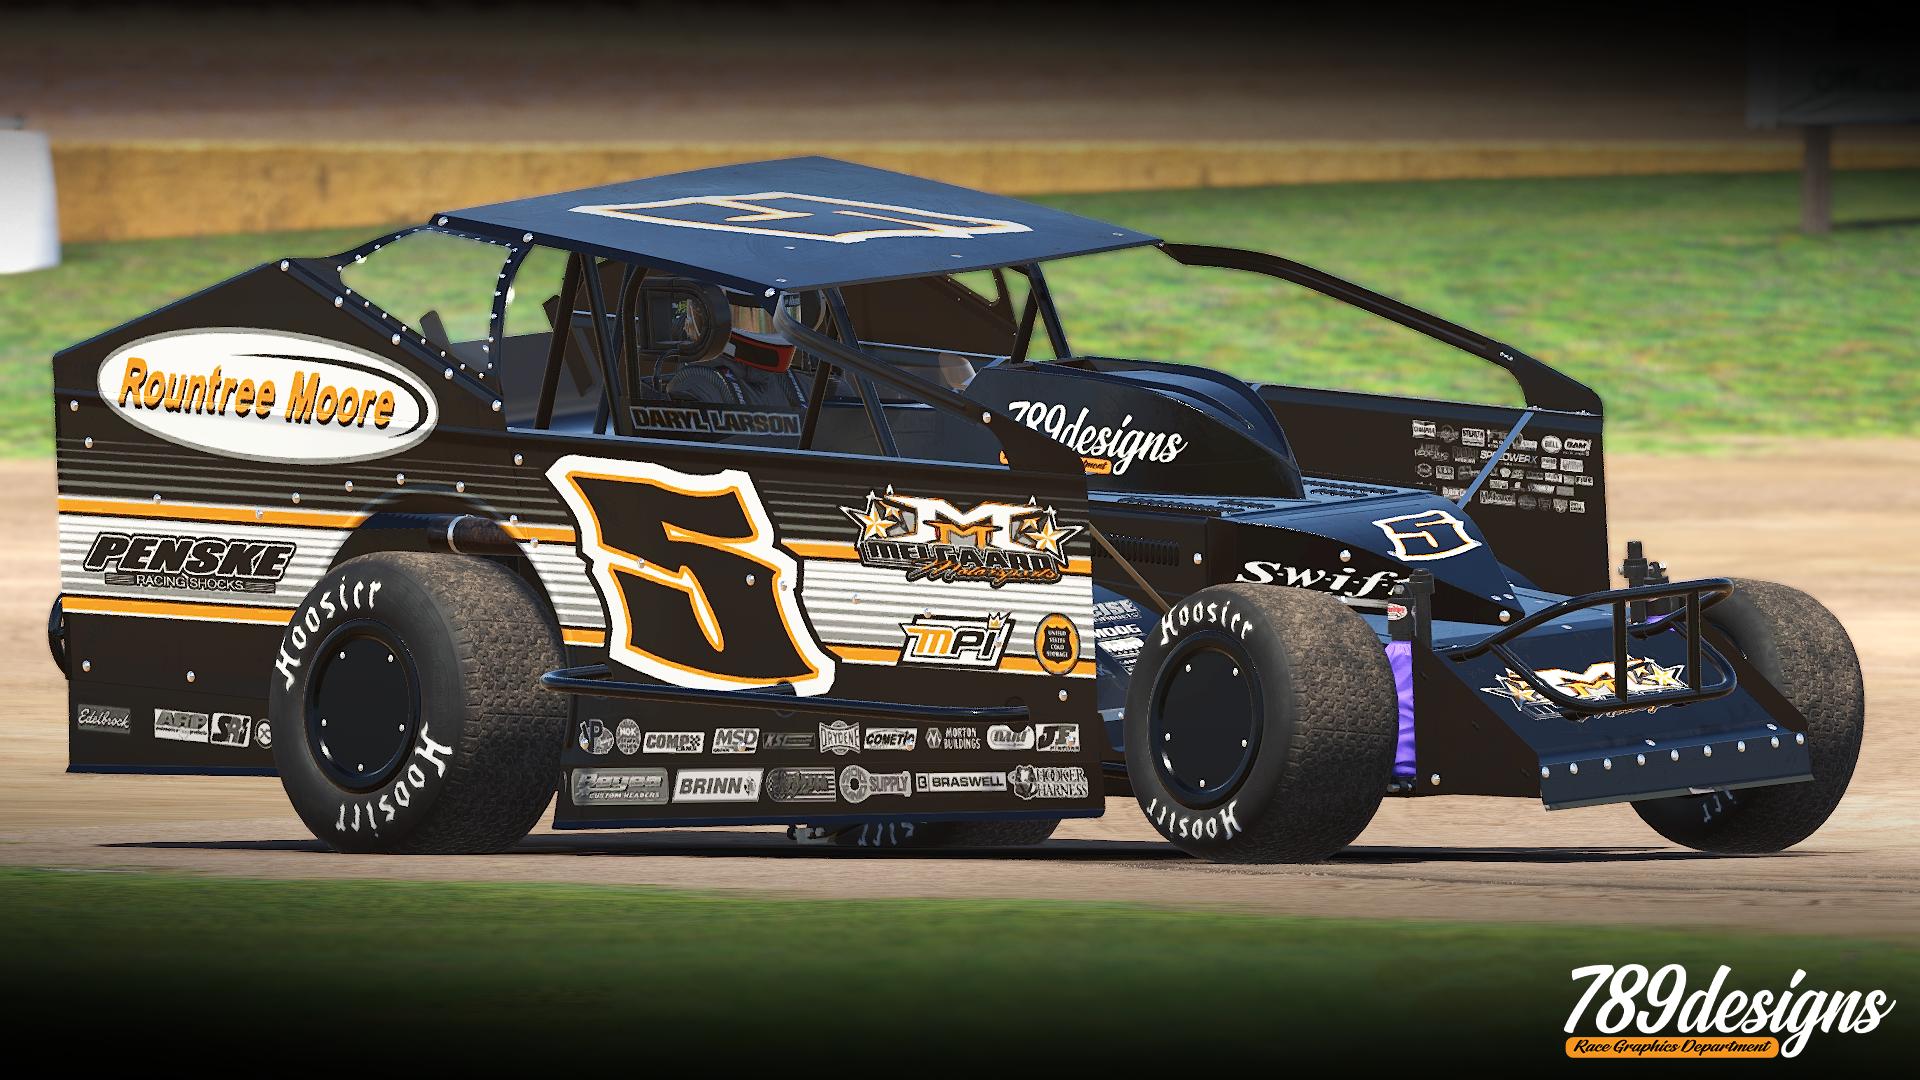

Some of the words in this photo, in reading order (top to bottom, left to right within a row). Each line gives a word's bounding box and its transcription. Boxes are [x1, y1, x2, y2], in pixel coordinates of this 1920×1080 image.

[118, 357, 276, 419] Rountree
[284, 370, 396, 430] Moore
[633, 407, 709, 431] DARYL
[711, 410, 800, 435] LARSON
[1371, 509, 1483, 562] 5
[84, 533, 296, 580] PENSKE
[861, 540, 1054, 573] MELGAARD
[136, 574, 187, 588] RACING
[189, 577, 244, 590] SHOCKS
[545, 454, 836, 697] 5
[78, 708, 131, 729] Edelbrock
[155, 710, 208, 729] ARP
[715, 729, 758, 746] MSD
[945, 727, 977, 738] MORTON
[645, 734, 691, 750] COMP
[943, 738, 981, 750] BUILDINGS
[868, 775, 909, 792] SUPPLY
[932, 776, 1005, 788] BRASWELL
[1035, 768, 1085, 782] HOOKER
[679, 777, 743, 794] BRINN
[1036, 783, 1088, 797] HARNESS
[588, 791, 622, 799] CUSTOM
[623, 791, 660, 799] HEADERS
